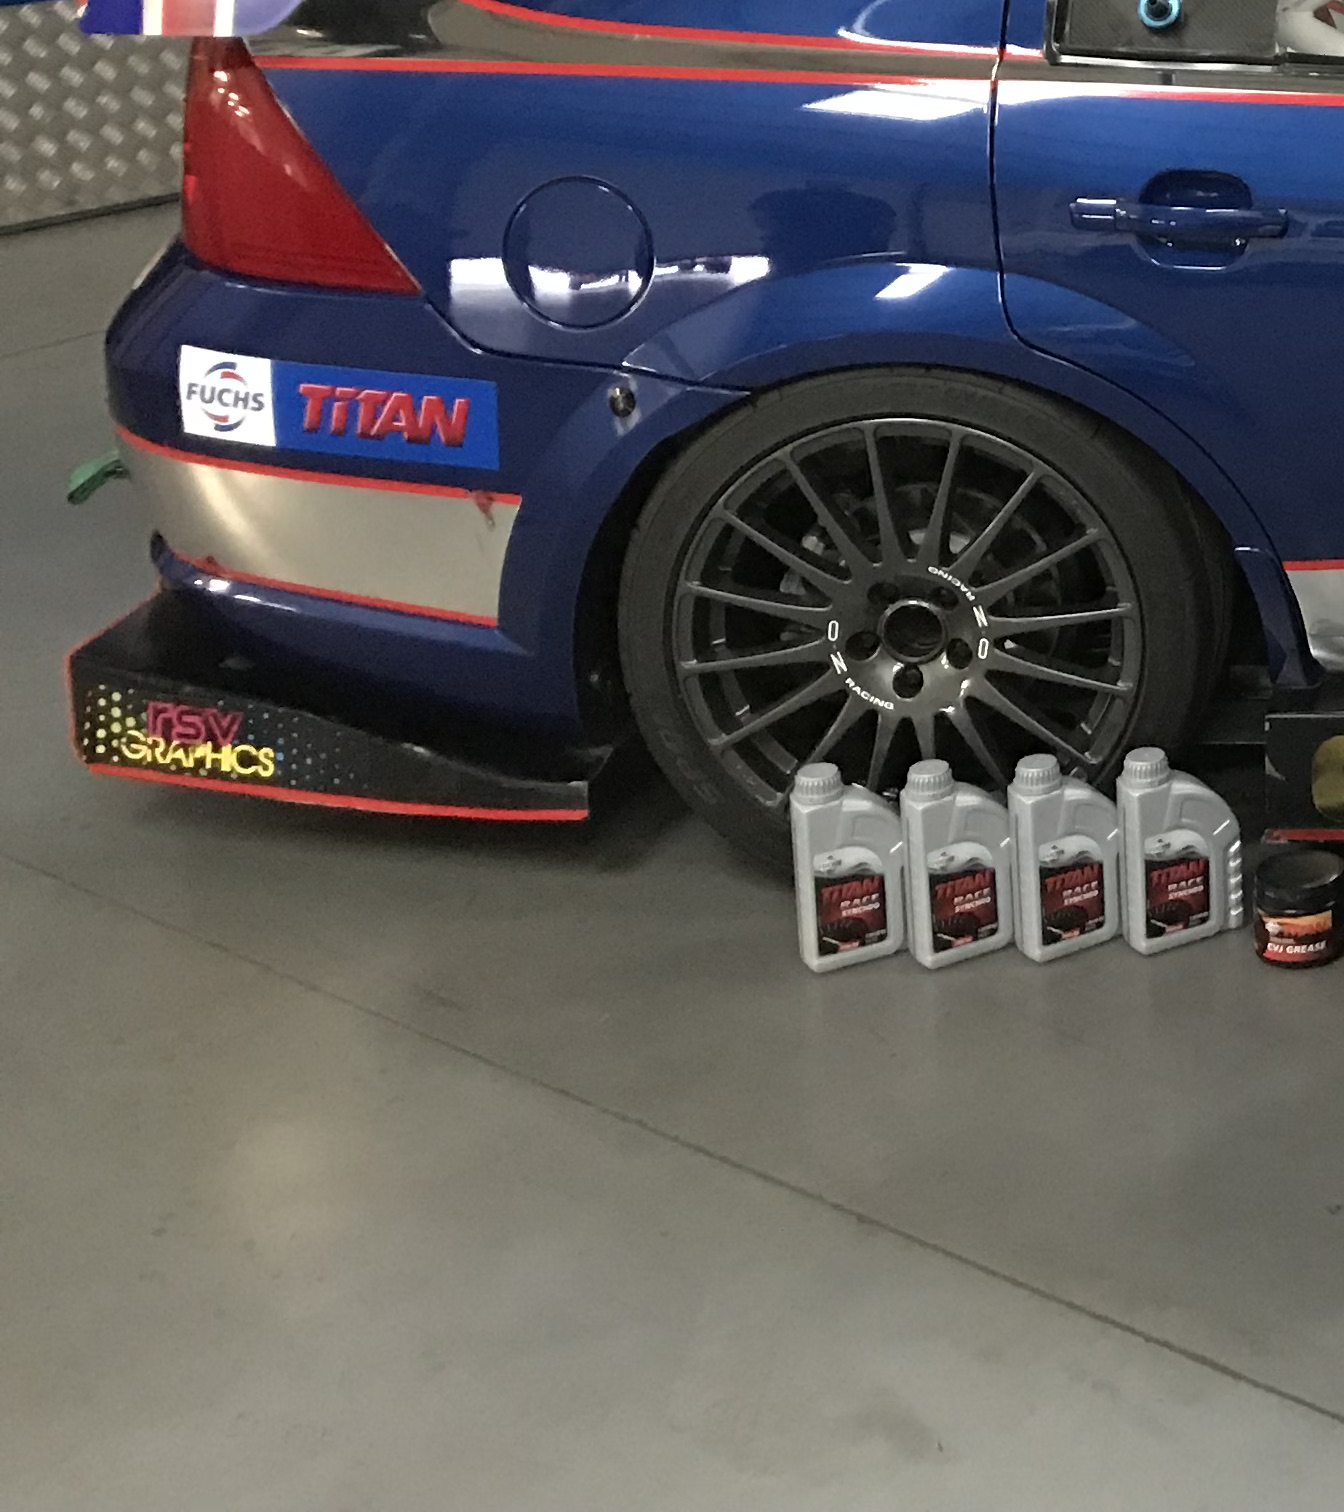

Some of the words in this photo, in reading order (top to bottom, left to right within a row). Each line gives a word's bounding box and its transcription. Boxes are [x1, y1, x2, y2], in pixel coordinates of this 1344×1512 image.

[186, 382, 266, 413] FUCHS
[845, 677, 895, 711] RACING
[147, 700, 246, 745] rsv
[121, 730, 276, 778] GRAPHICS
